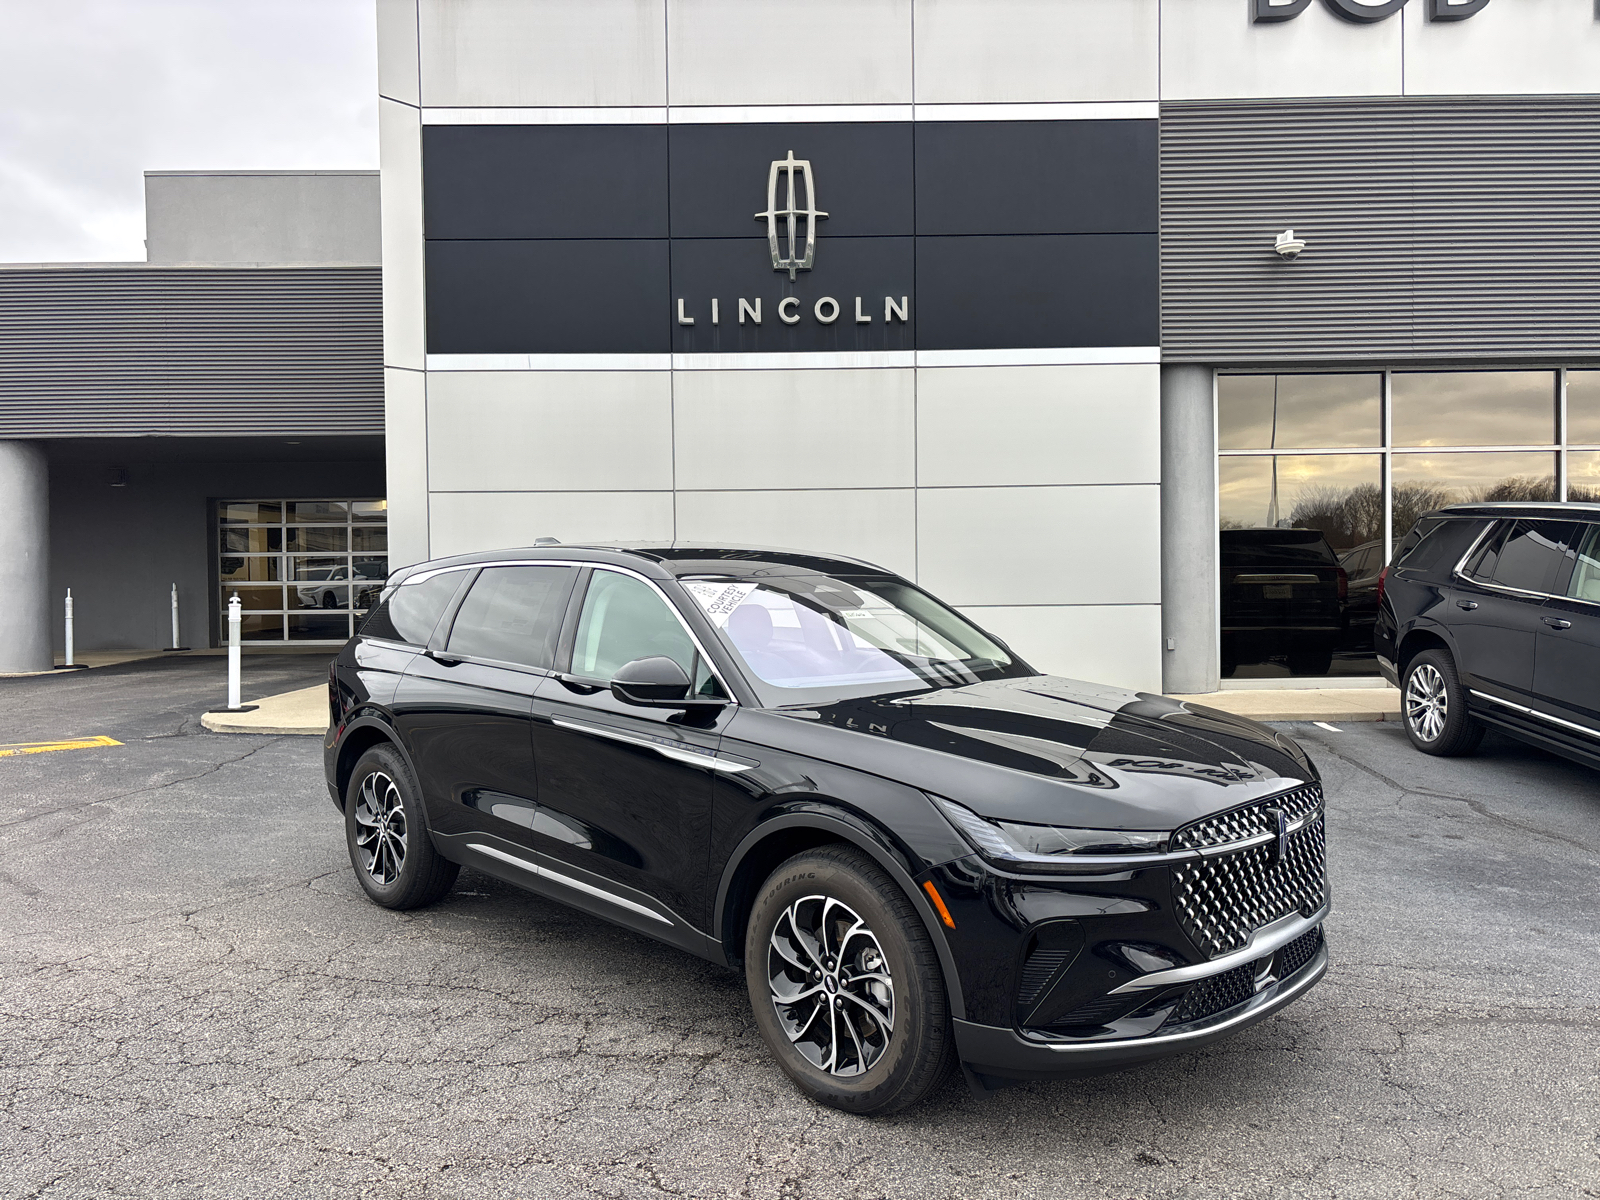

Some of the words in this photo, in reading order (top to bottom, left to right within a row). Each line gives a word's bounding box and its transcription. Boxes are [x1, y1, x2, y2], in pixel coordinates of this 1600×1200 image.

[678, 296, 908, 325] LINCOLN
[707, 584, 739, 614] COURTESY
[719, 590, 747, 615] VEHICLE
[763, 872, 816, 906] TOURING
